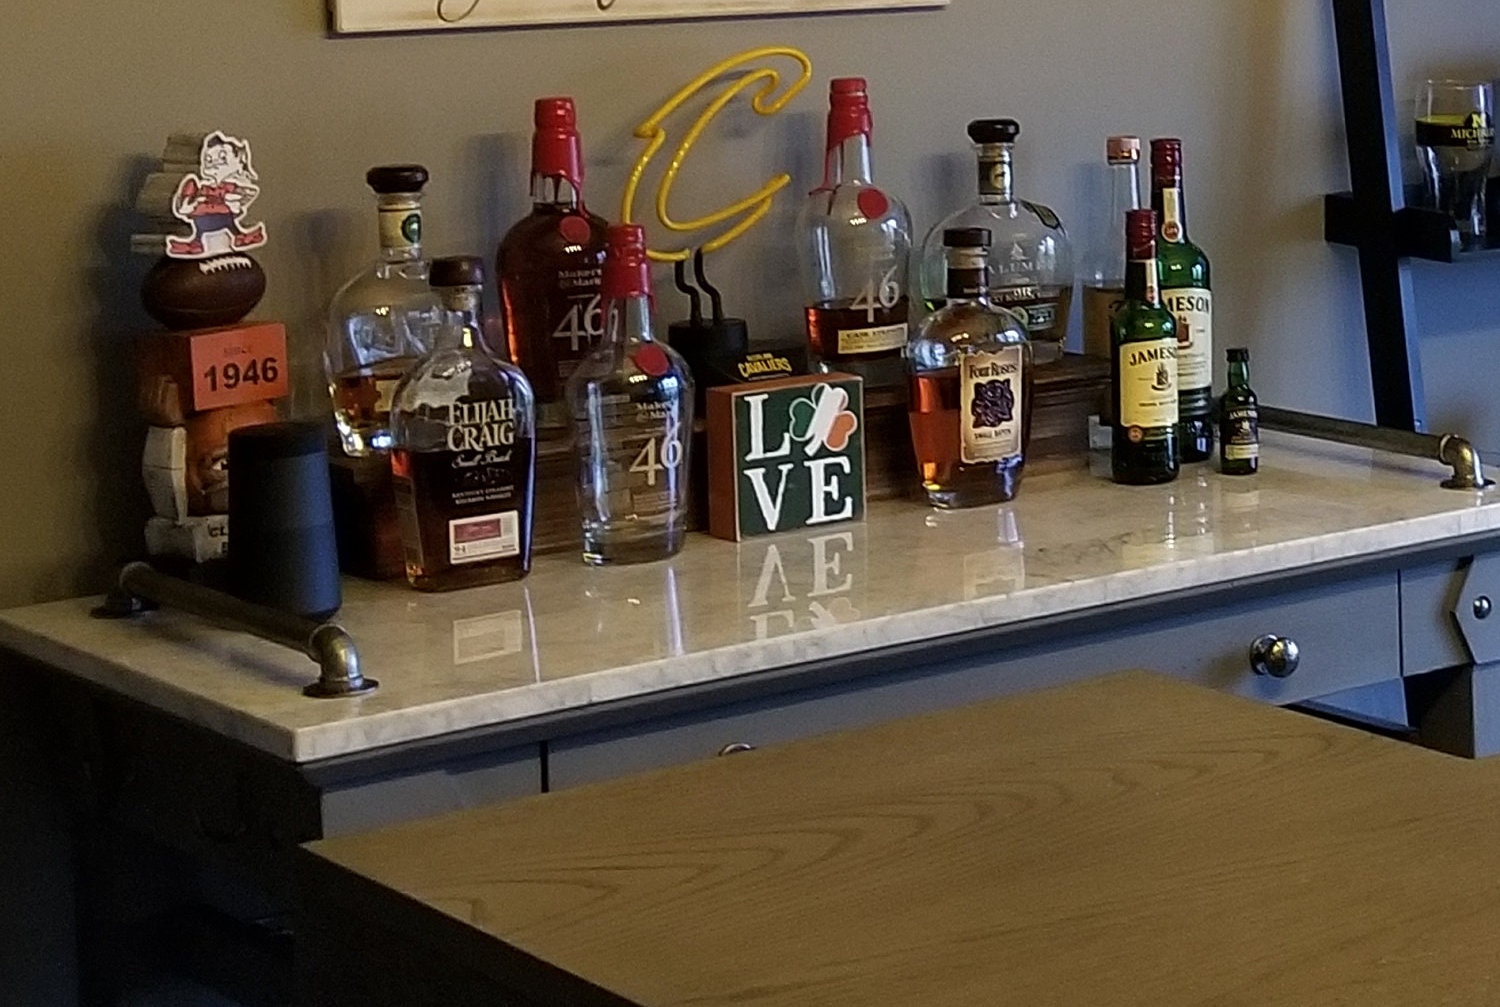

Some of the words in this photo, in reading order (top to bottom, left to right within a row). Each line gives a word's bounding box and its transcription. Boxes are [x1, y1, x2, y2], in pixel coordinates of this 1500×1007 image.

[849, 263, 900, 323] 46
[204, 357, 278, 392] 1946
[738, 357, 792, 378] CAVALIERS
[448, 399, 513, 426] ELIJAH
[447, 422, 514, 451] CRAIG
[629, 422, 683, 485] 46
